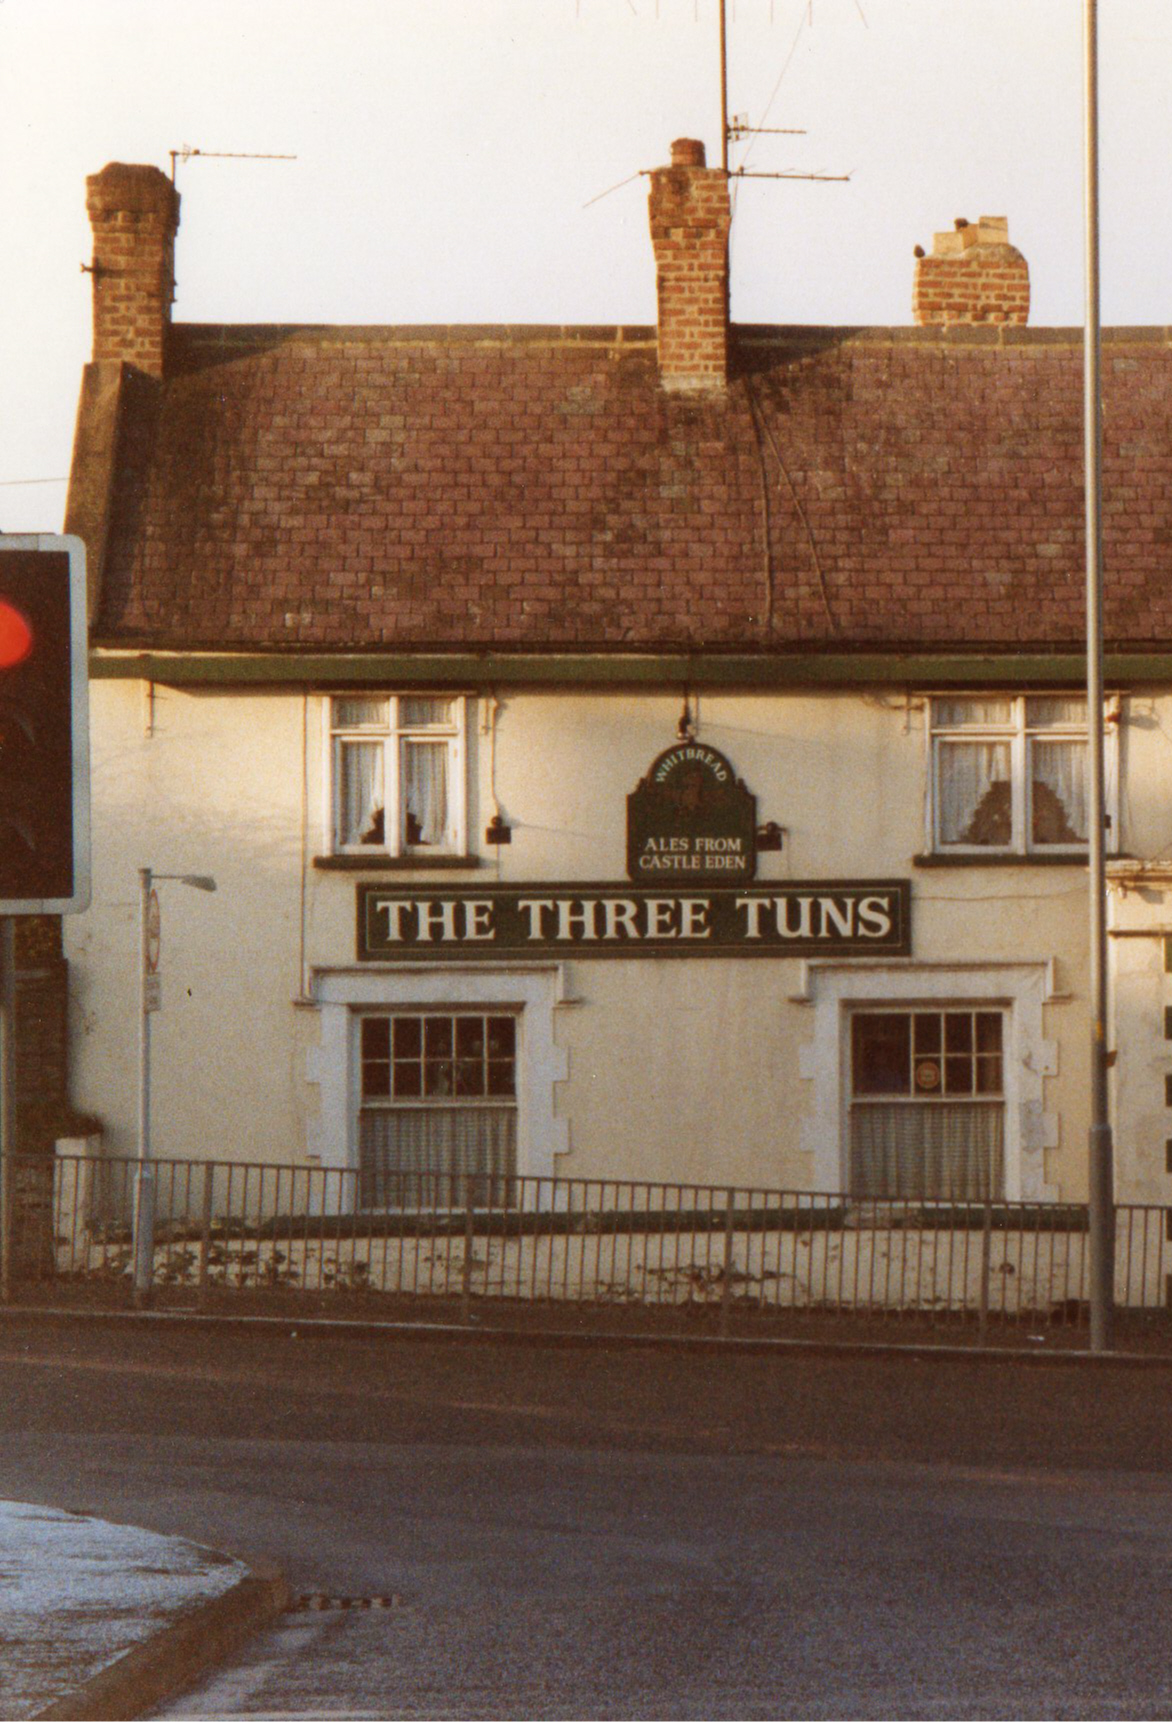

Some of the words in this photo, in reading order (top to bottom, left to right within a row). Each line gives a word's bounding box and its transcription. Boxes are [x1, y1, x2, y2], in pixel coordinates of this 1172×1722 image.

[655, 748, 727, 782] WHITBREAD
[644, 837, 689, 852] ALES
[695, 837, 742, 852] FROM
[639, 854, 700, 870] CASTLE
[705, 854, 746, 870] EDEN
[376, 900, 495, 941] THE
[517, 899, 711, 940] THREE
[735, 896, 892, 938] TUNS
